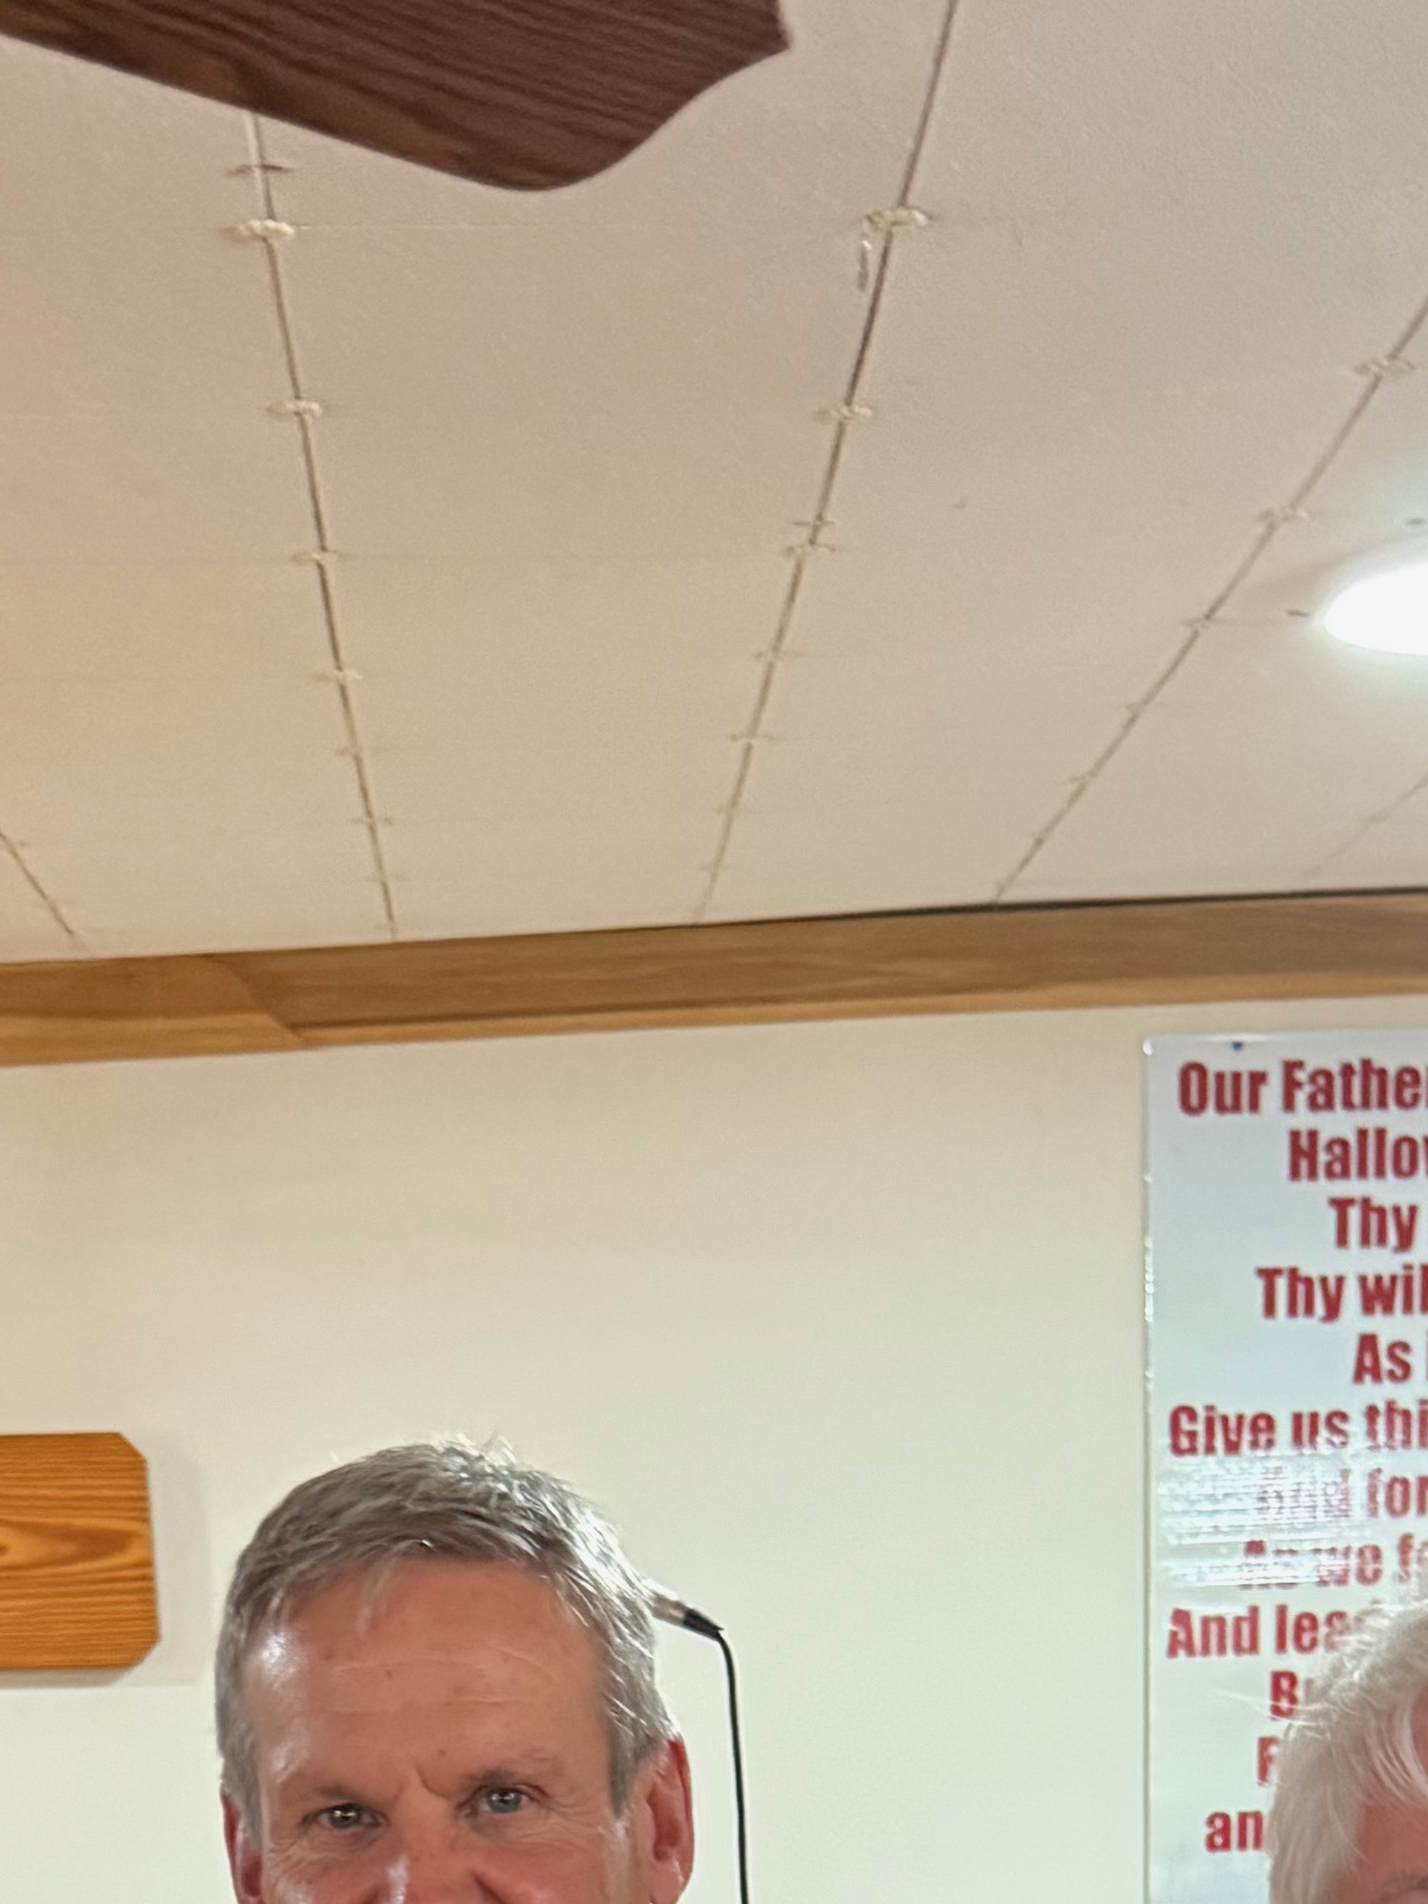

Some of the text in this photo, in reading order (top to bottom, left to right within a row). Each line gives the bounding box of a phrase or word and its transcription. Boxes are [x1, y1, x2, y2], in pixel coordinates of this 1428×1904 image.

[1179, 1061, 1268, 1115] Our
[1330, 1197, 1417, 1252] Thy
[1258, 1267, 1344, 1322] Thy
[1354, 1333, 1411, 1383] As
[1170, 1405, 1276, 1456] Give
[1292, 1410, 1350, 1450] us
[1167, 1606, 1259, 1658] And
